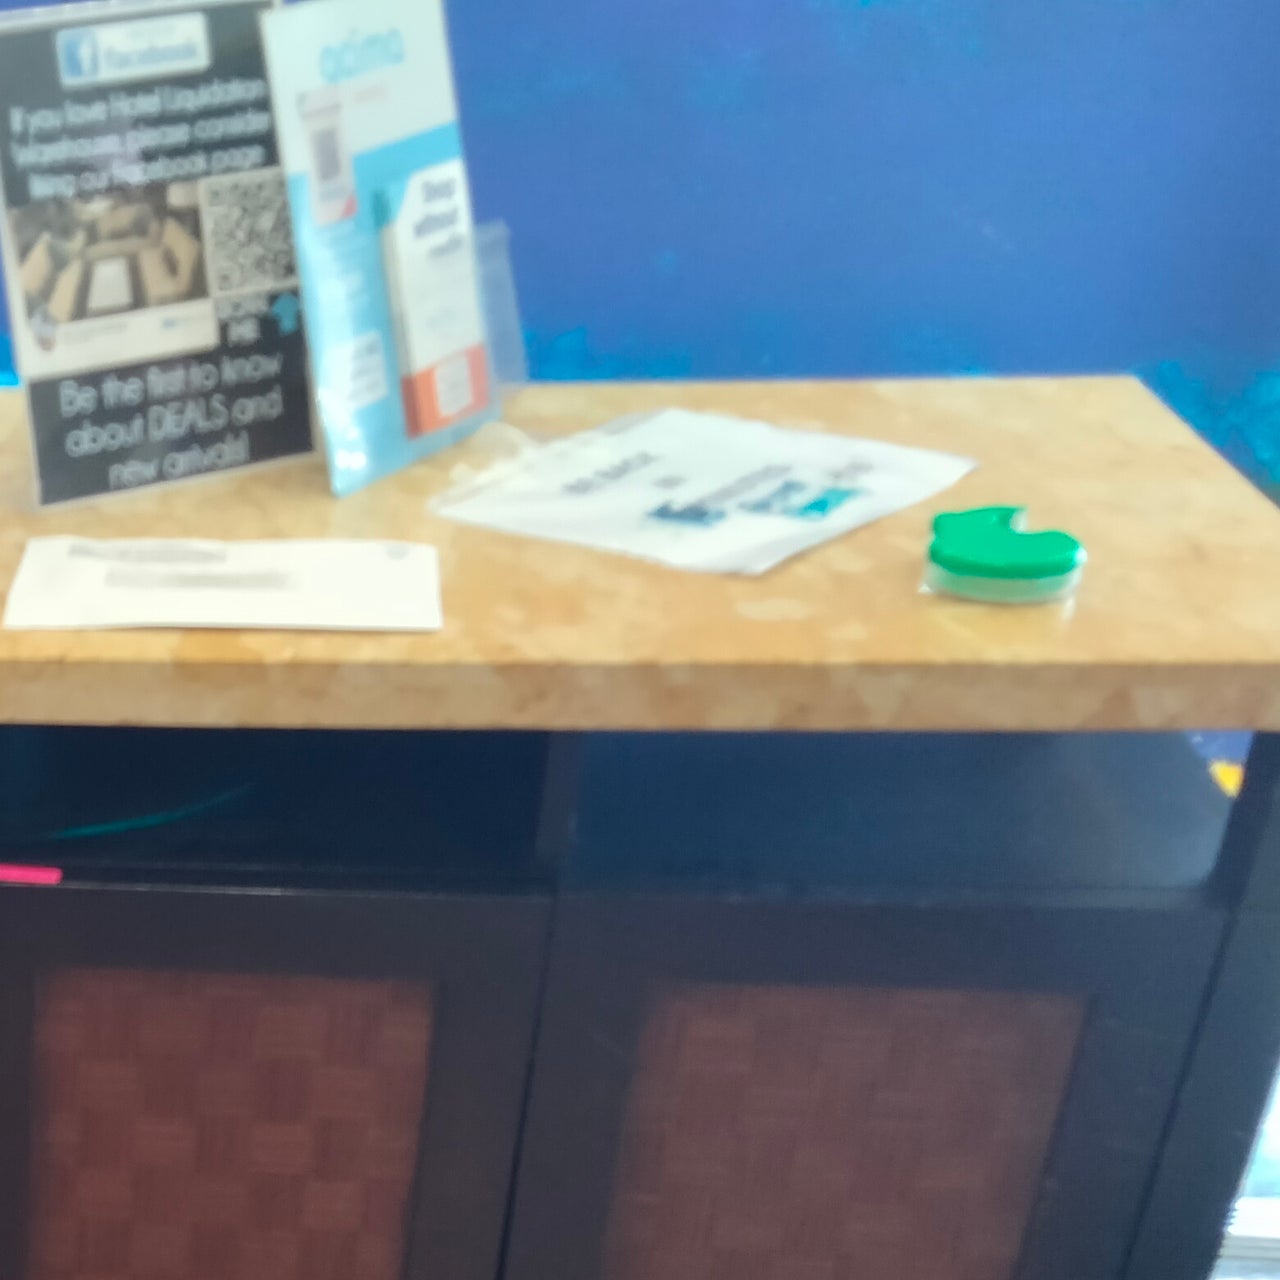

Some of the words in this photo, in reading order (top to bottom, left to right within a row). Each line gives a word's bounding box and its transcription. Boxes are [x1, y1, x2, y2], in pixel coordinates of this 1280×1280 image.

[59, 378, 99, 418] Be
[101, 372, 144, 410] the
[146, 365, 186, 400] first
[187, 359, 220, 393] to
[221, 353, 284, 386] know
[64, 412, 145, 458] about
[147, 393, 229, 443] DEALS
[231, 384, 285, 427] and
[108, 457, 161, 490] new
